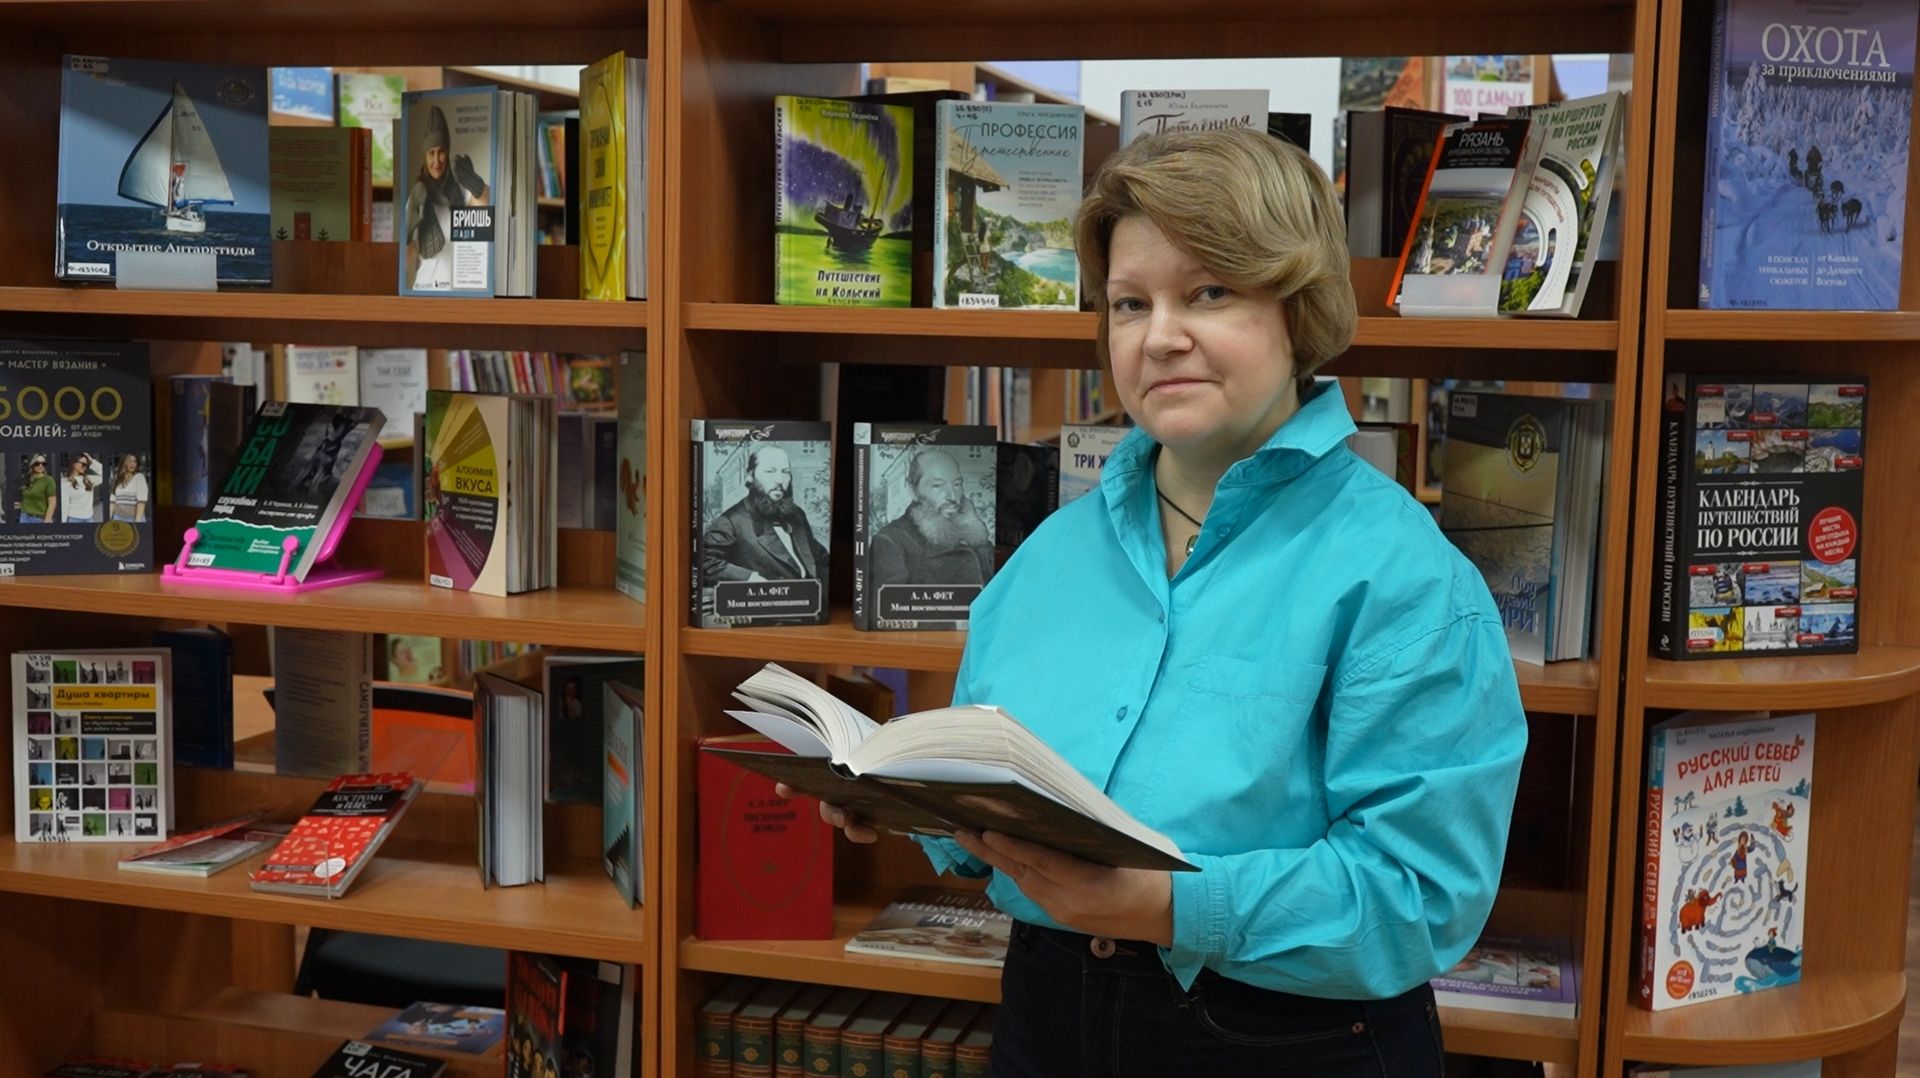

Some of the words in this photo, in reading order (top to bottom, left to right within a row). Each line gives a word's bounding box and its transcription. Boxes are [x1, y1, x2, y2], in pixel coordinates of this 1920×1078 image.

[1762, 23, 1890, 67] ОХОТА
[1761, 64, 1775, 76] за
[1779, 65, 1896, 82] приключениями
[1454, 88, 1472, 106] 100
[1477, 88, 1525, 106] САМЫХ
[1550, 103, 1607, 125] МАРШРУТОВ
[981, 123, 1077, 140] ПРОФЕССИЯ
[1552, 127, 1564, 139] ПО
[1564, 120, 1603, 137] ГОРОДАМ
[1459, 132, 1504, 147] РЯЗАНЬ
[1566, 134, 1599, 151] РОССИИ
[453, 209, 491, 227] БРИОШЬ
[87, 240, 162, 253] Открытие
[165, 243, 256, 256] Антарктиды
[8, 360, 49, 369] МАСТЕР
[52, 360, 98, 370] ВЯЗАНИЯ
[1074, 454, 1095, 469] ТРИ
[1667, 421, 1679, 484] КАЛЕНДАРЬ
[455, 465, 494, 477] АЛХИМИЯ
[455, 476, 493, 493] ВКУСА
[1699, 488, 1801, 509] КАЛЕНДАРЬ
[1663, 485, 1677, 563] ПУТЕШЕСТВИЙ
[1698, 507, 1800, 526] ПУТЕШЕСТВИЙ
[1697, 529, 1723, 548] ПО
[1727, 527, 1799, 548] РОССИИ
[855, 569, 864, 591] ФЕТ
[1663, 565, 1674, 580] ПО
[746, 588, 757, 597] А.
[758, 587, 768, 596] А.
[769, 586, 790, 596] ФЕТ
[910, 592, 921, 601] А.
[922, 592, 932, 601] А.
[933, 591, 954, 601] ФЕТ
[726, 600, 746, 609] Мои
[747, 599, 810, 608] воспоминания
[890, 603, 910, 612] Мои
[911, 604, 970, 612] воспоминани
[1662, 580, 1673, 622] РОССИИ
[56, 688, 90, 700] Душа
[94, 689, 150, 700] квартиры
[359, 682, 370, 752] САМОУЧИТЕЛЬ
[1677, 741, 1750, 780] РУССКИЙ
[1754, 743, 1800, 762] СЕВЕР
[1703, 768, 1734, 794] ДЛЯ
[1738, 762, 1782, 786] ДЕТЕЙ
[332, 793, 383, 802] КОСТРОМА
[1649, 793, 1661, 857] РУССКИЙ
[1646, 861, 1657, 901] СЕВЕР
[344, 1057, 412, 1078] ЧАГА
